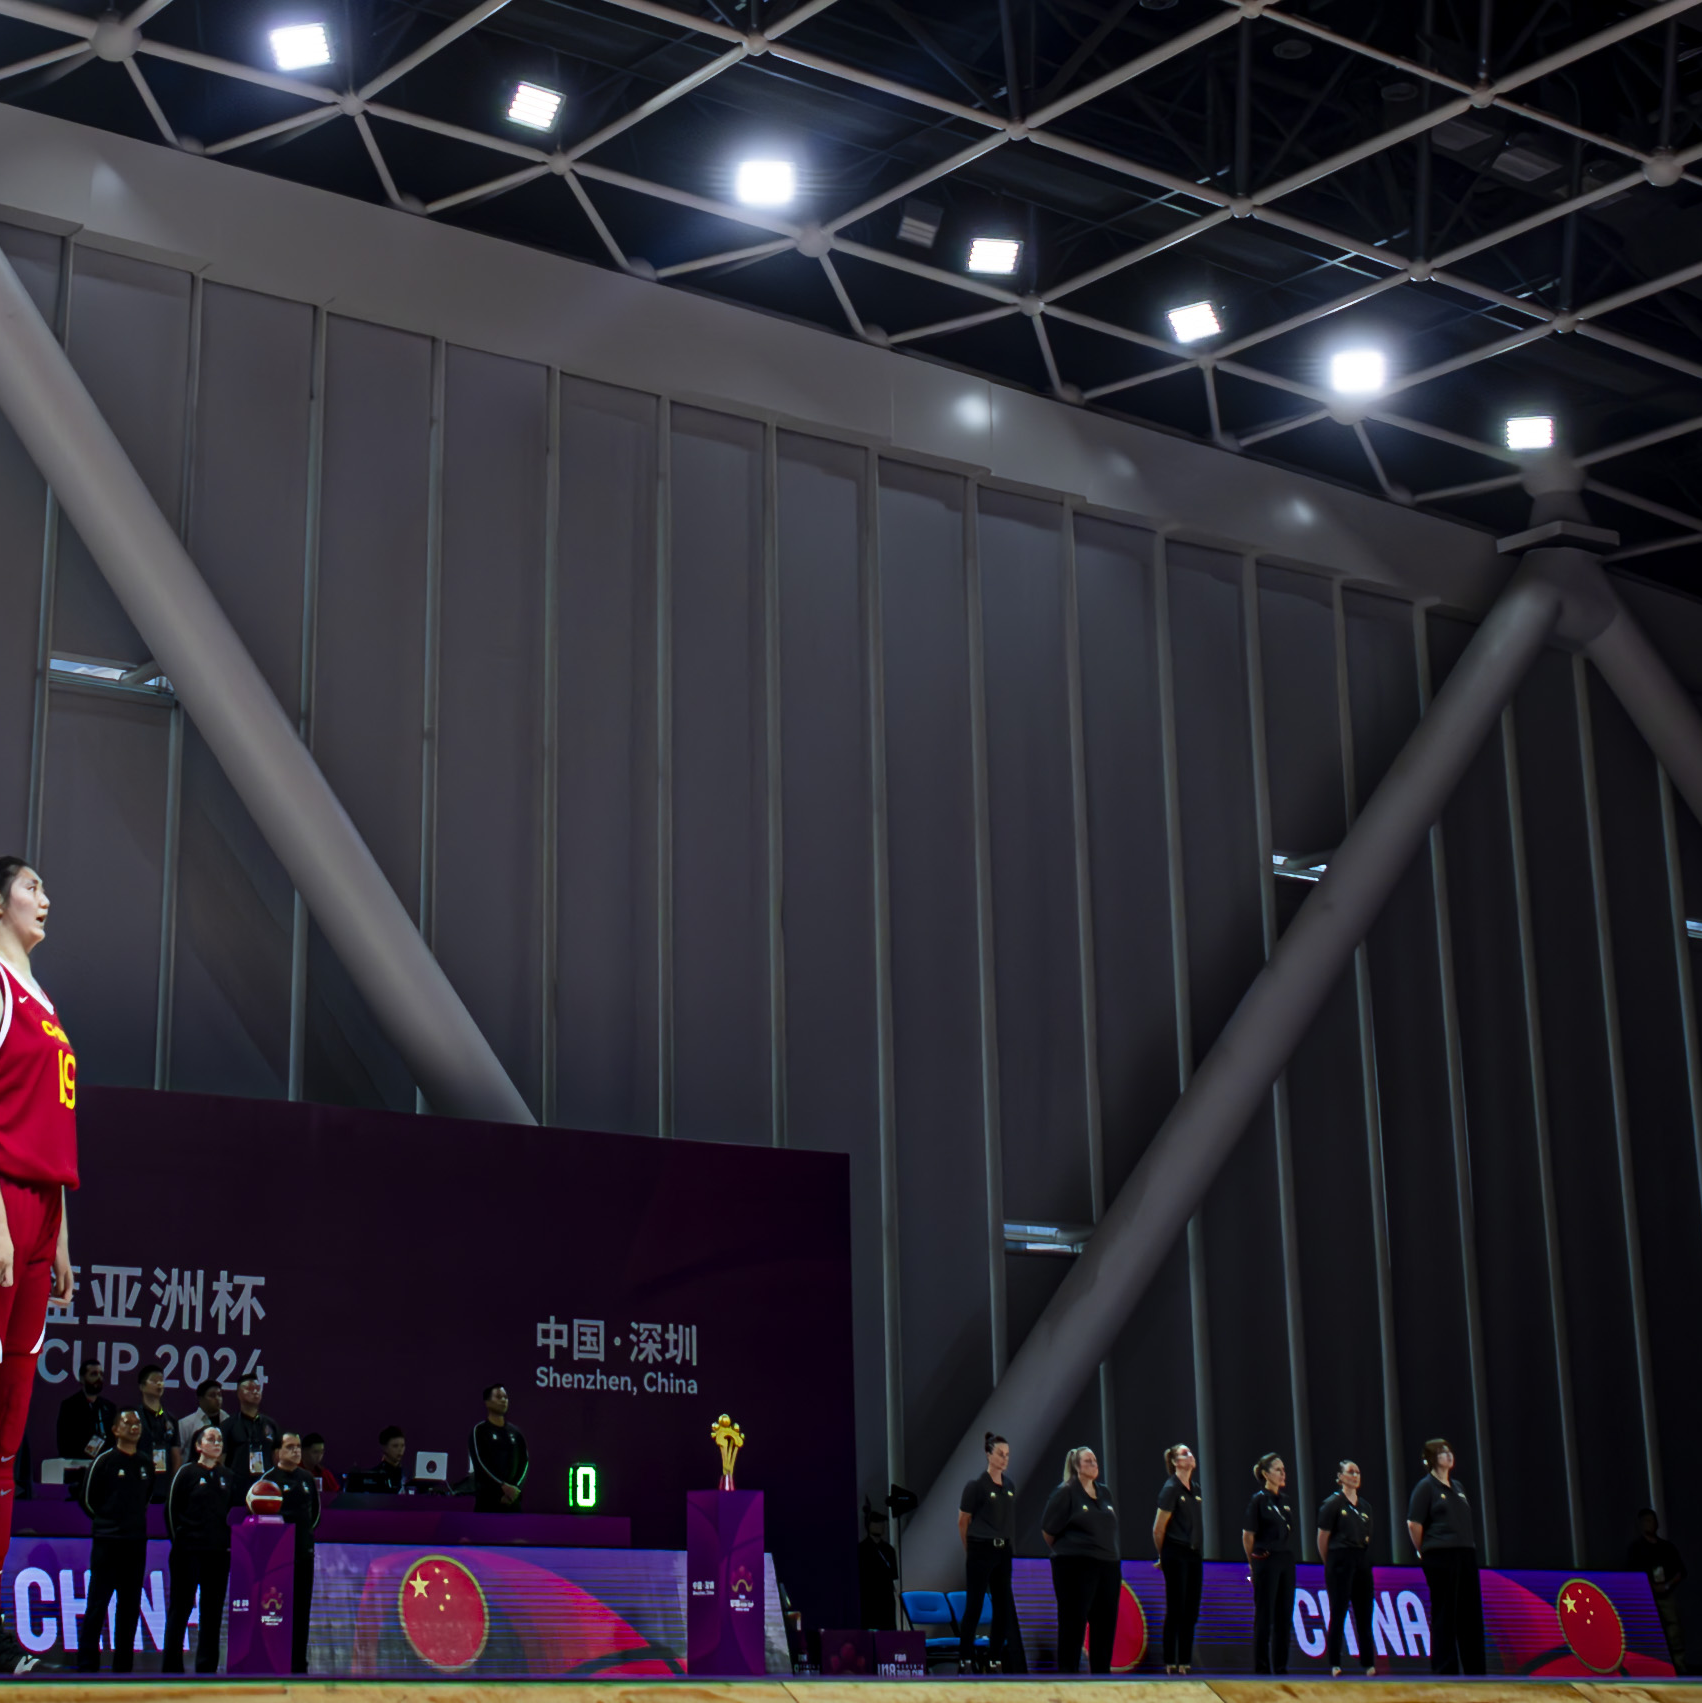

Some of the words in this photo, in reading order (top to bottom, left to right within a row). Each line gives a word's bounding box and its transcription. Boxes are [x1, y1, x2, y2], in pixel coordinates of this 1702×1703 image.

[58, 1049, 76, 1110] 19
[36, 1338, 140, 1386] CUP
[154, 1343, 269, 1394] 2024
[535, 1366, 638, 1396] Shenzhen,
[643, 1371, 698, 1395] China
